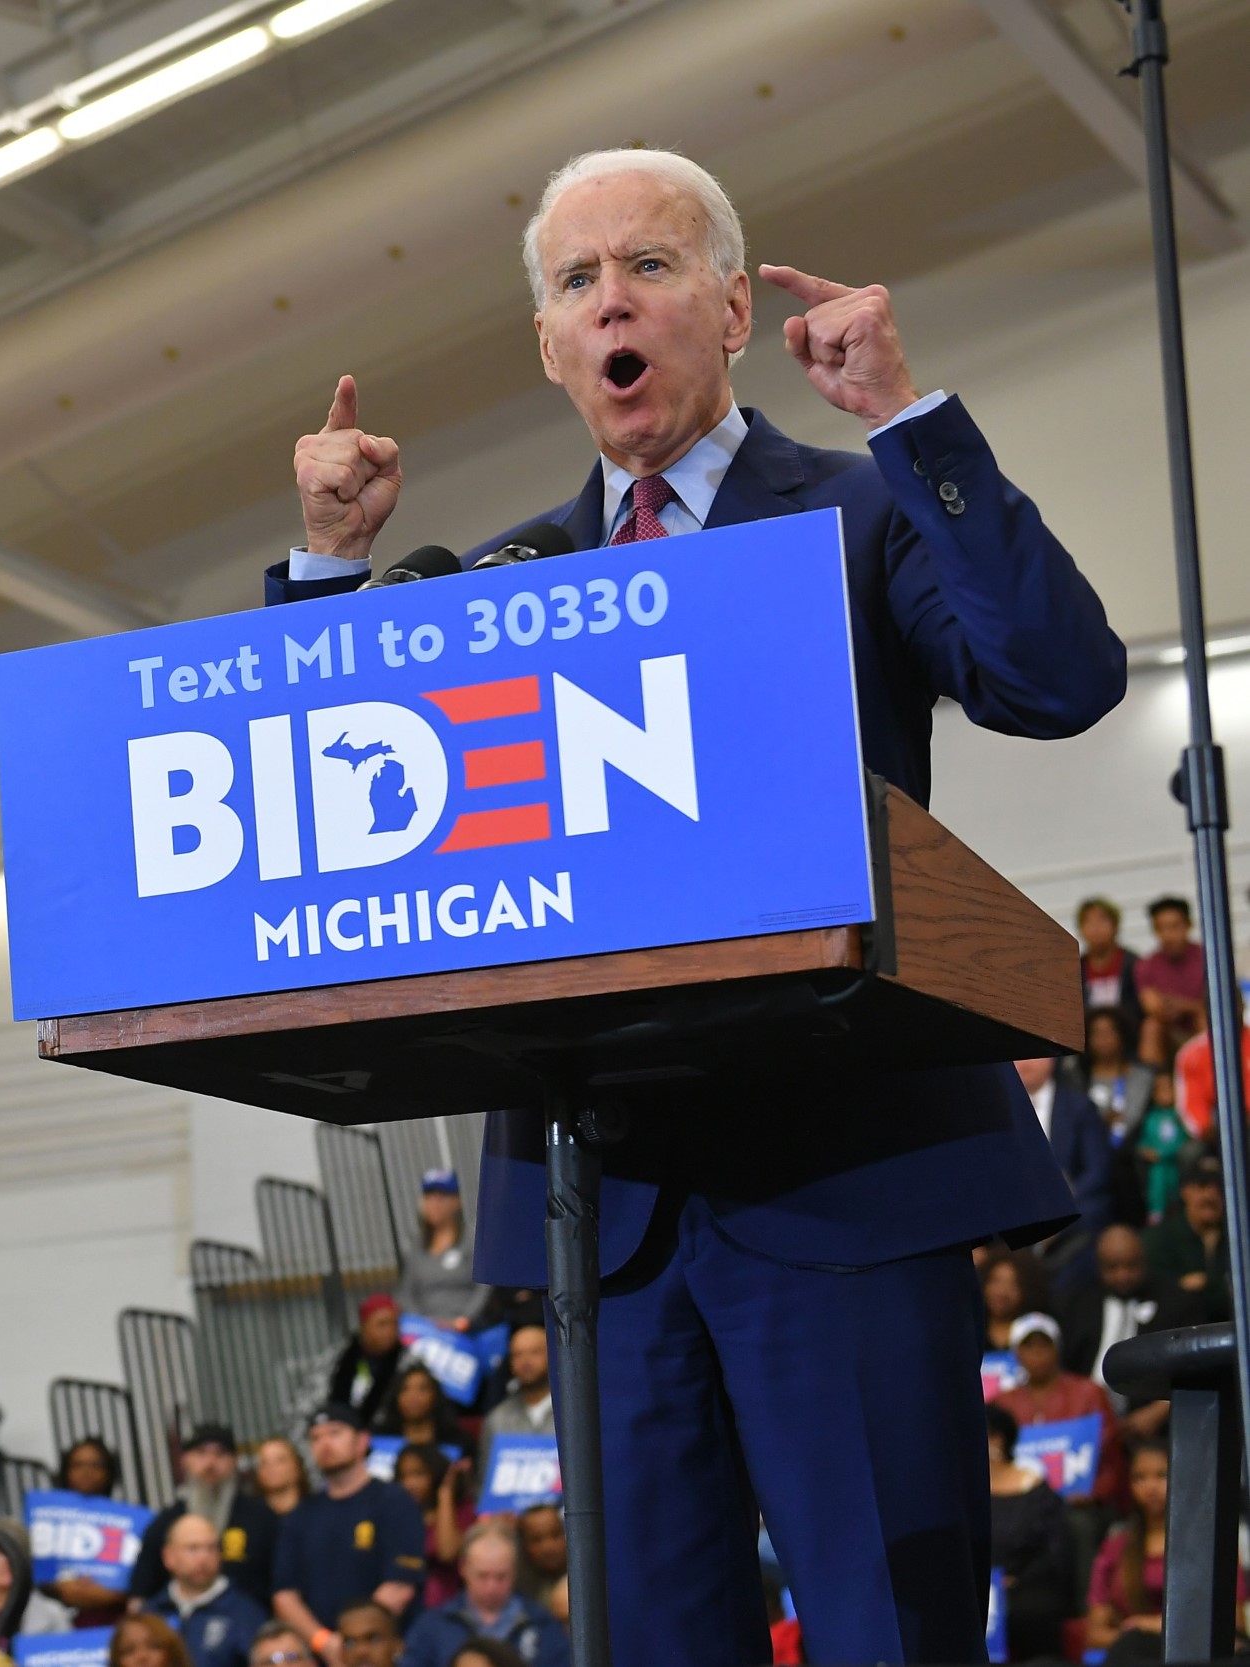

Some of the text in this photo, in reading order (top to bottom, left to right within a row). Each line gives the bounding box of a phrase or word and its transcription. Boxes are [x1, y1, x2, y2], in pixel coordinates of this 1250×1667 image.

[128, 570, 669, 709] Text MI to 30330
[127, 653, 700, 899] BIDEN
[253, 870, 575, 962] MICHIGAN
[491, 1460, 561, 1497] BID
